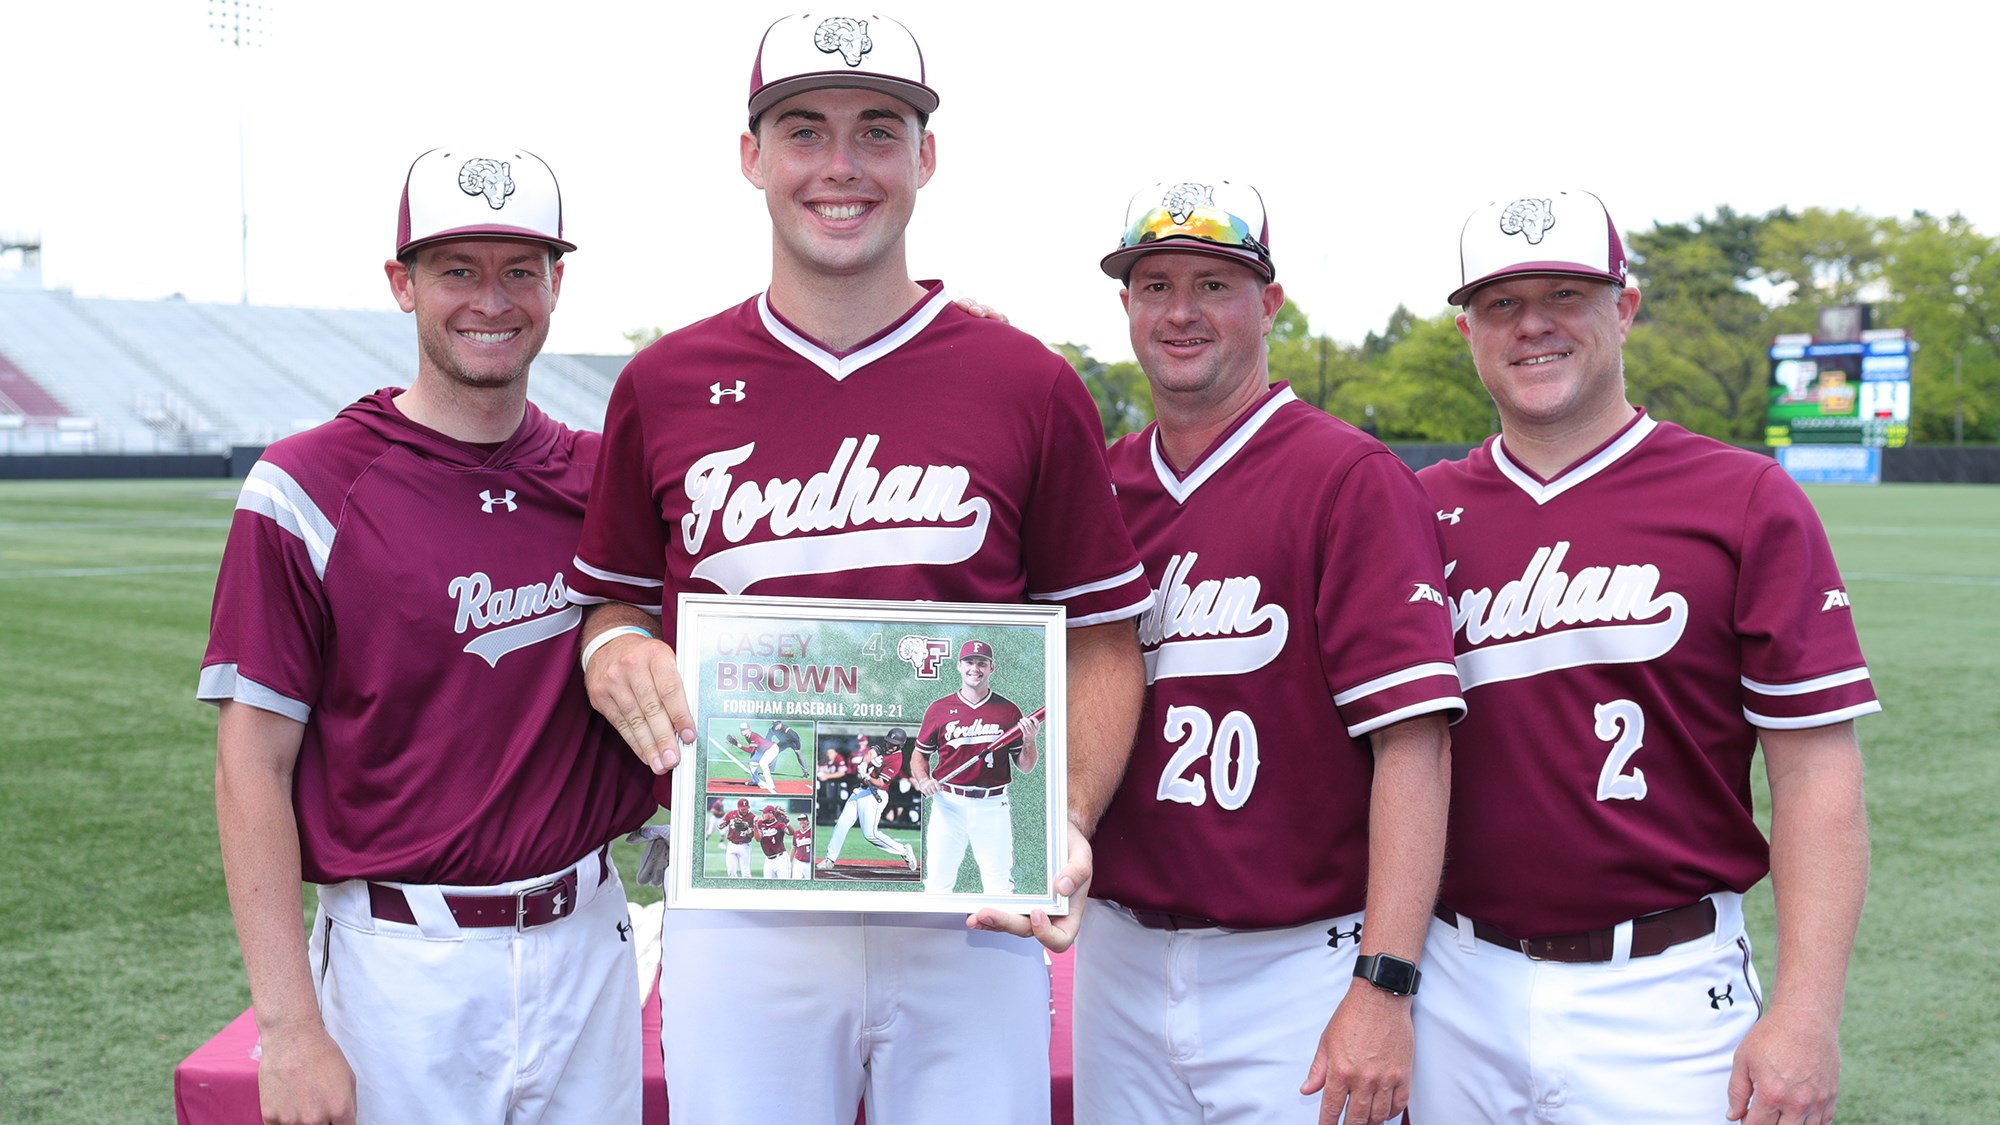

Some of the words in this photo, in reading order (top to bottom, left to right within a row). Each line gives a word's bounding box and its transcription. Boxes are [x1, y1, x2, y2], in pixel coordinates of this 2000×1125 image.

[681, 434, 975, 555] Fordham
[448, 572, 568, 634] Rams
[1138, 551, 1262, 646] dham
[1444, 541, 1661, 645] rdham
[716, 632, 813, 658] CASEY
[862, 633, 886, 662] 4
[716, 662, 858, 695] BROWN
[723, 699, 782, 715] FORDHAM
[786, 701, 845, 716] BASEBALL
[852, 703, 902, 718] 2018-21
[944, 718, 1003, 740] Fordham
[1156, 705, 1261, 811] 20
[1594, 699, 1648, 801] 2
